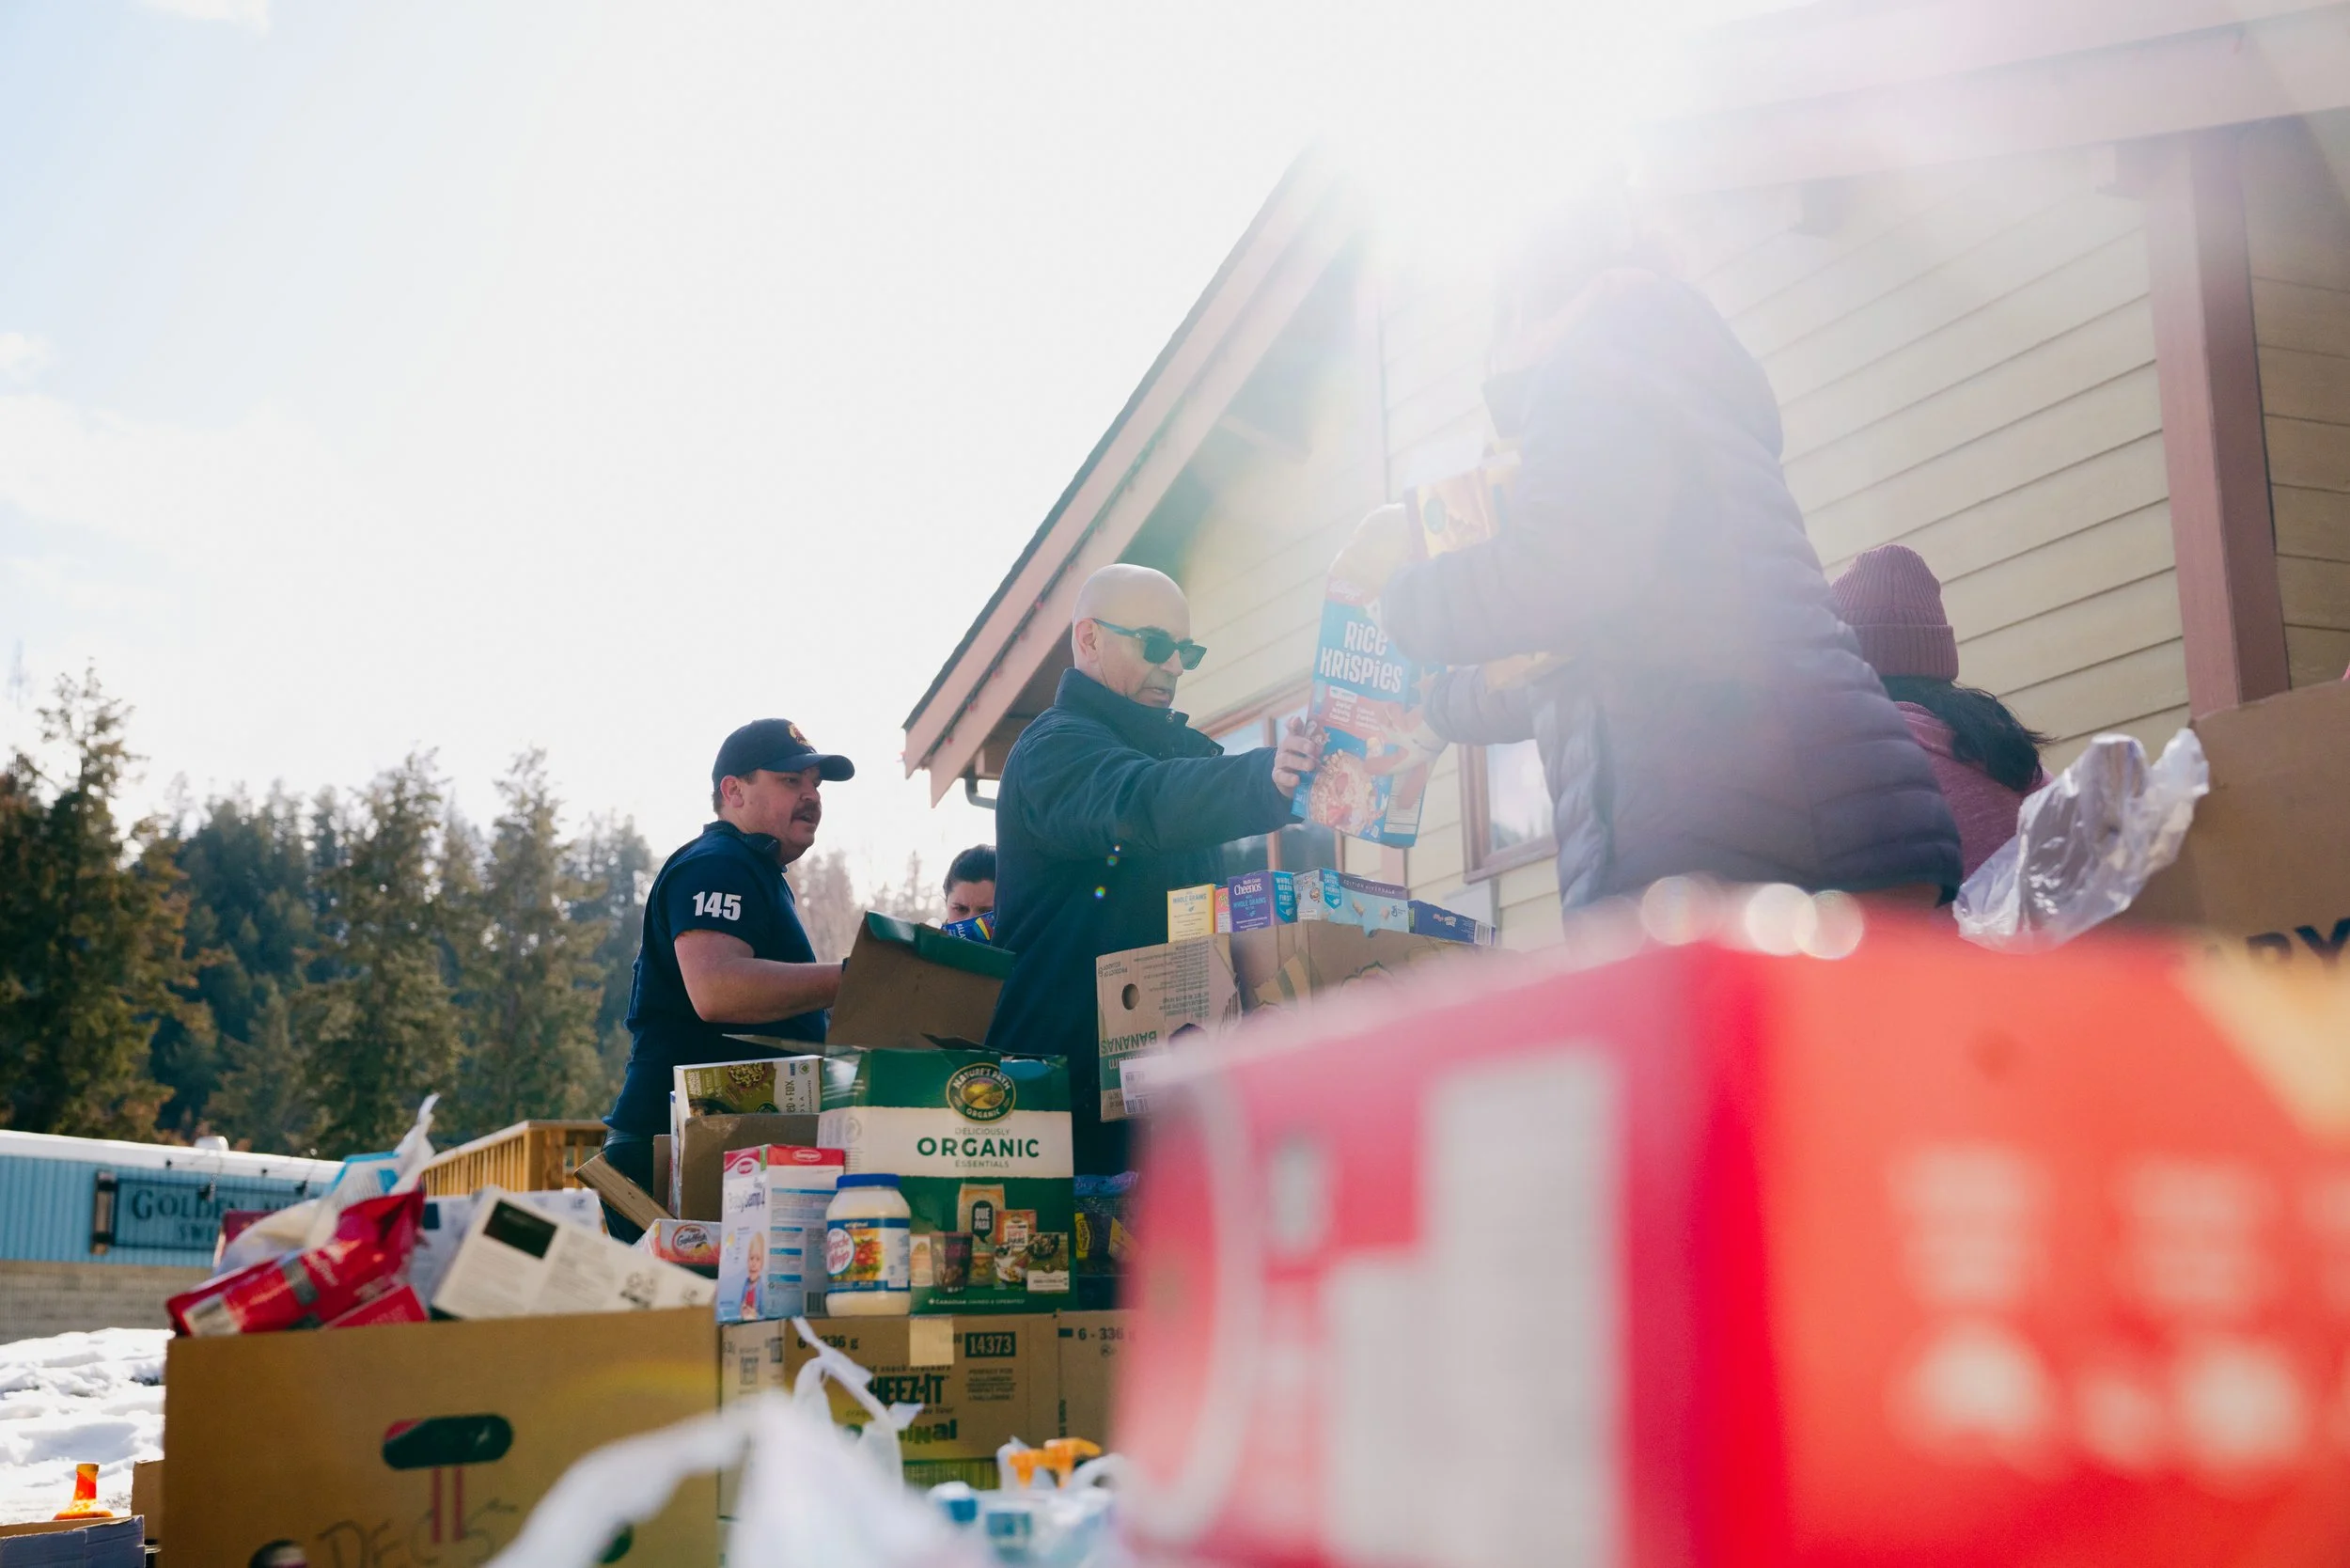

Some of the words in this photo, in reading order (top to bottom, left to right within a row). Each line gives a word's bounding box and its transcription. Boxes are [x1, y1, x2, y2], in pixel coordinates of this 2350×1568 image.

[692, 891, 742, 921] 145
[1101, 1030, 1157, 1055] BANANAS
[954, 1127, 1010, 1136] DELICIOUSLY
[916, 1137, 1040, 1158] ORGANIC
[954, 1159, 1010, 1168] ESSENTIALS
[1077, 1326, 1089, 1341] 6
[969, 1335, 1013, 1356] 14373
[867, 1373, 946, 1406] HEEZ-IT
